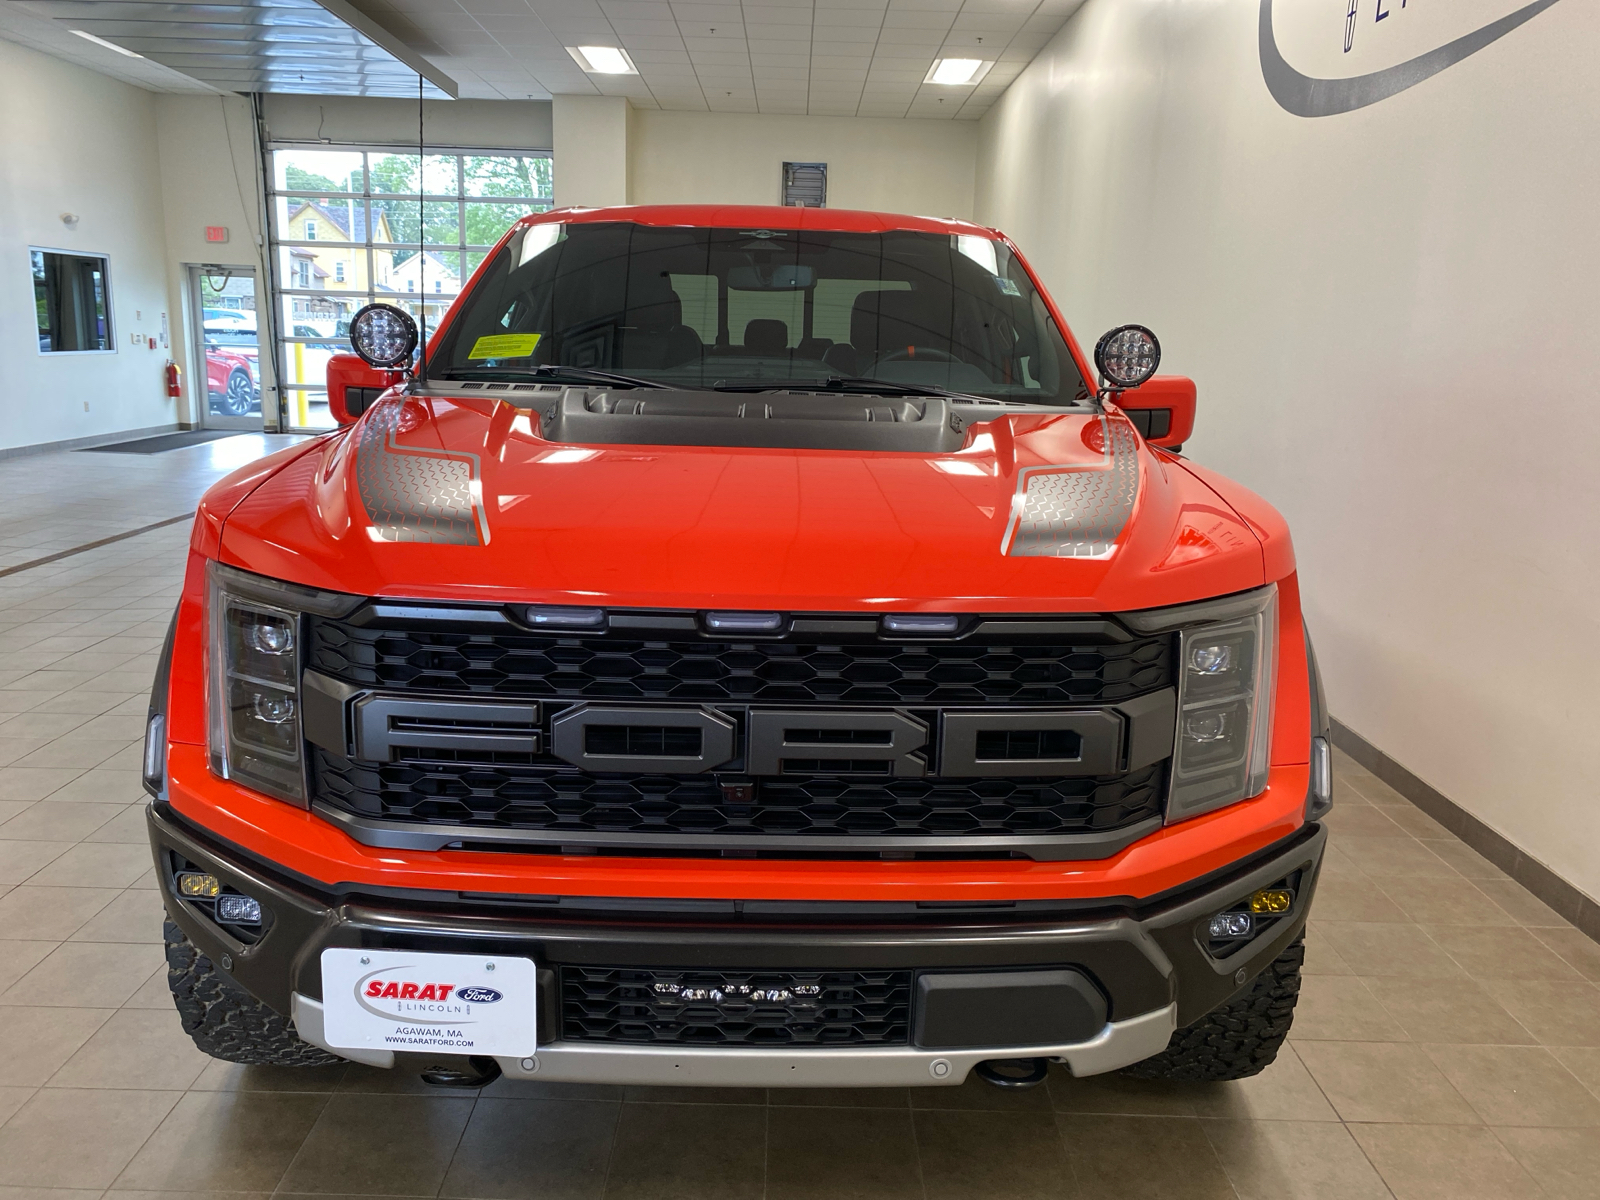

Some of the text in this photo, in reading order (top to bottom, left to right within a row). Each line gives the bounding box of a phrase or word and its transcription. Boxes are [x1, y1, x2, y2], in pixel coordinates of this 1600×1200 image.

[206, 226, 224, 241] EXIT
[357, 700, 1120, 777] FORD
[364, 979, 495, 1003] SARAT Ford
[406, 1003, 461, 1013] LINCOLN
[395, 1027, 463, 1038] AGAWAM, MA
[385, 1036, 474, 1047] WWW.SARATFORD.COM
